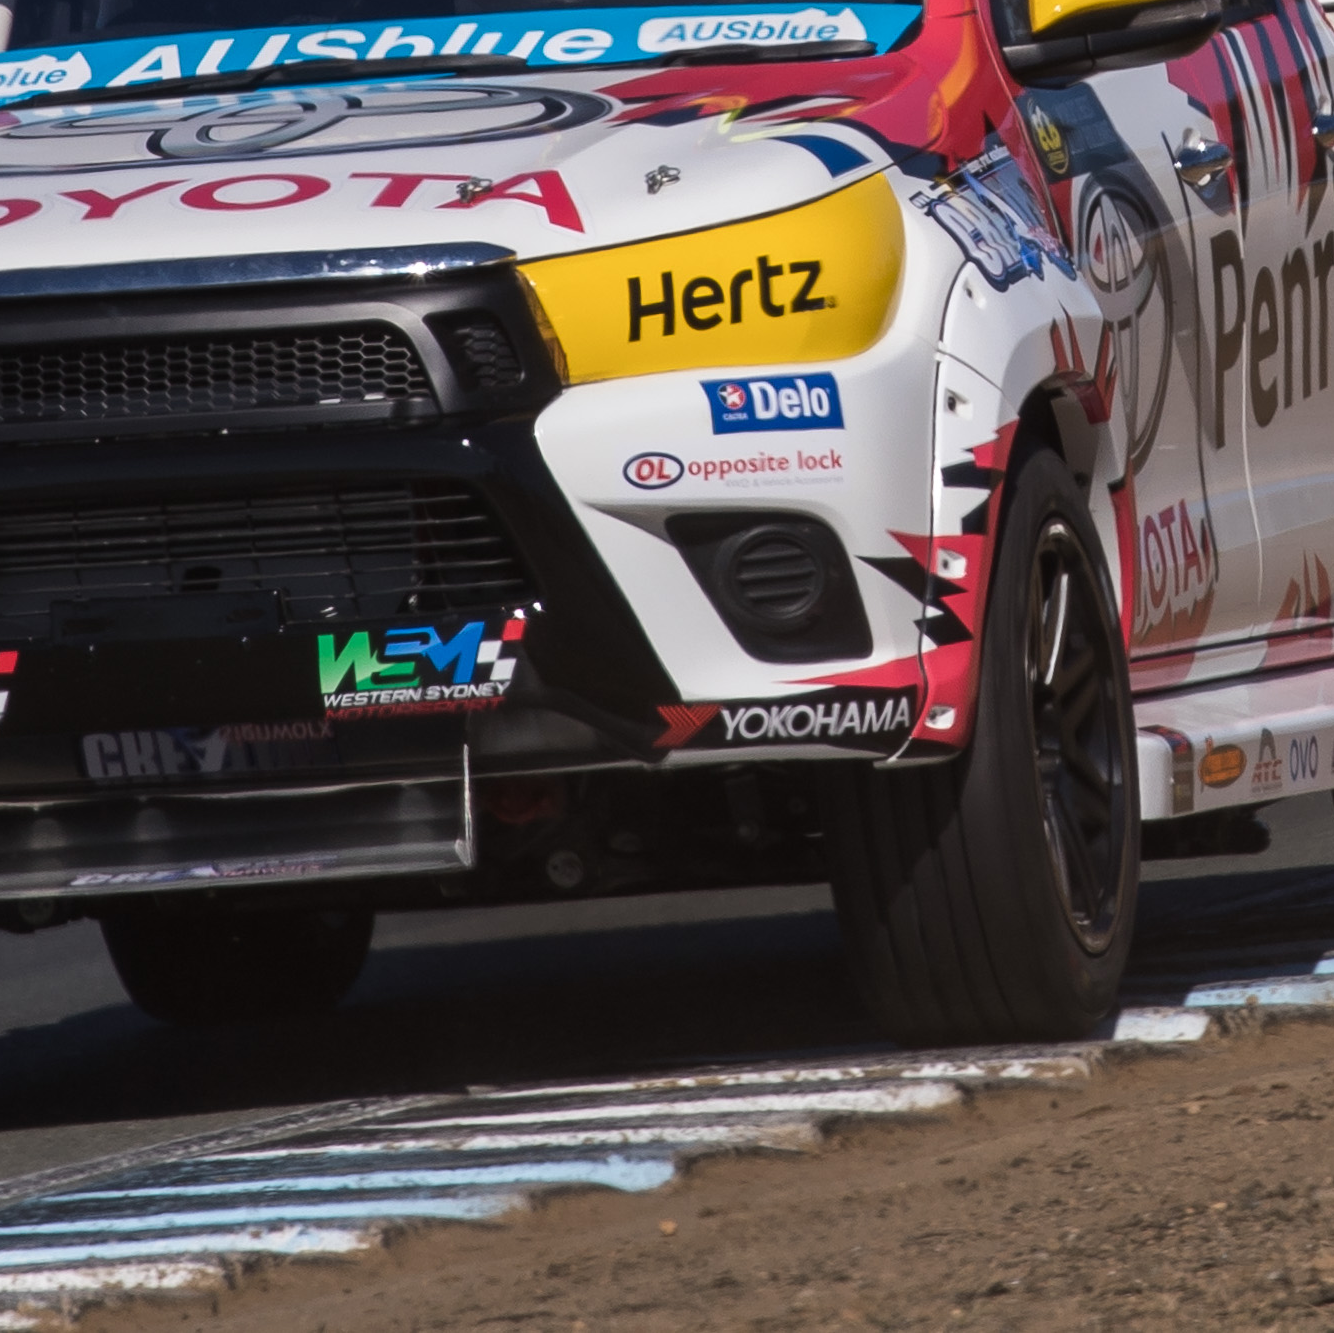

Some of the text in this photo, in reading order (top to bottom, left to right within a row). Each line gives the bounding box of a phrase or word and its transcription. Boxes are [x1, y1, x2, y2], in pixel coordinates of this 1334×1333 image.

[658, 19, 839, 43] AUSblue
[106, 23, 614, 88] AUSblue
[627, 254, 827, 342] Hertz
[748, 378, 831, 420] Delo
[634, 448, 843, 482] OL opposite lock
[1138, 498, 1205, 610] OTA
[323, 680, 512, 708] WESTERN SYDNEY
[720, 696, 913, 742] YOKOHAMA
